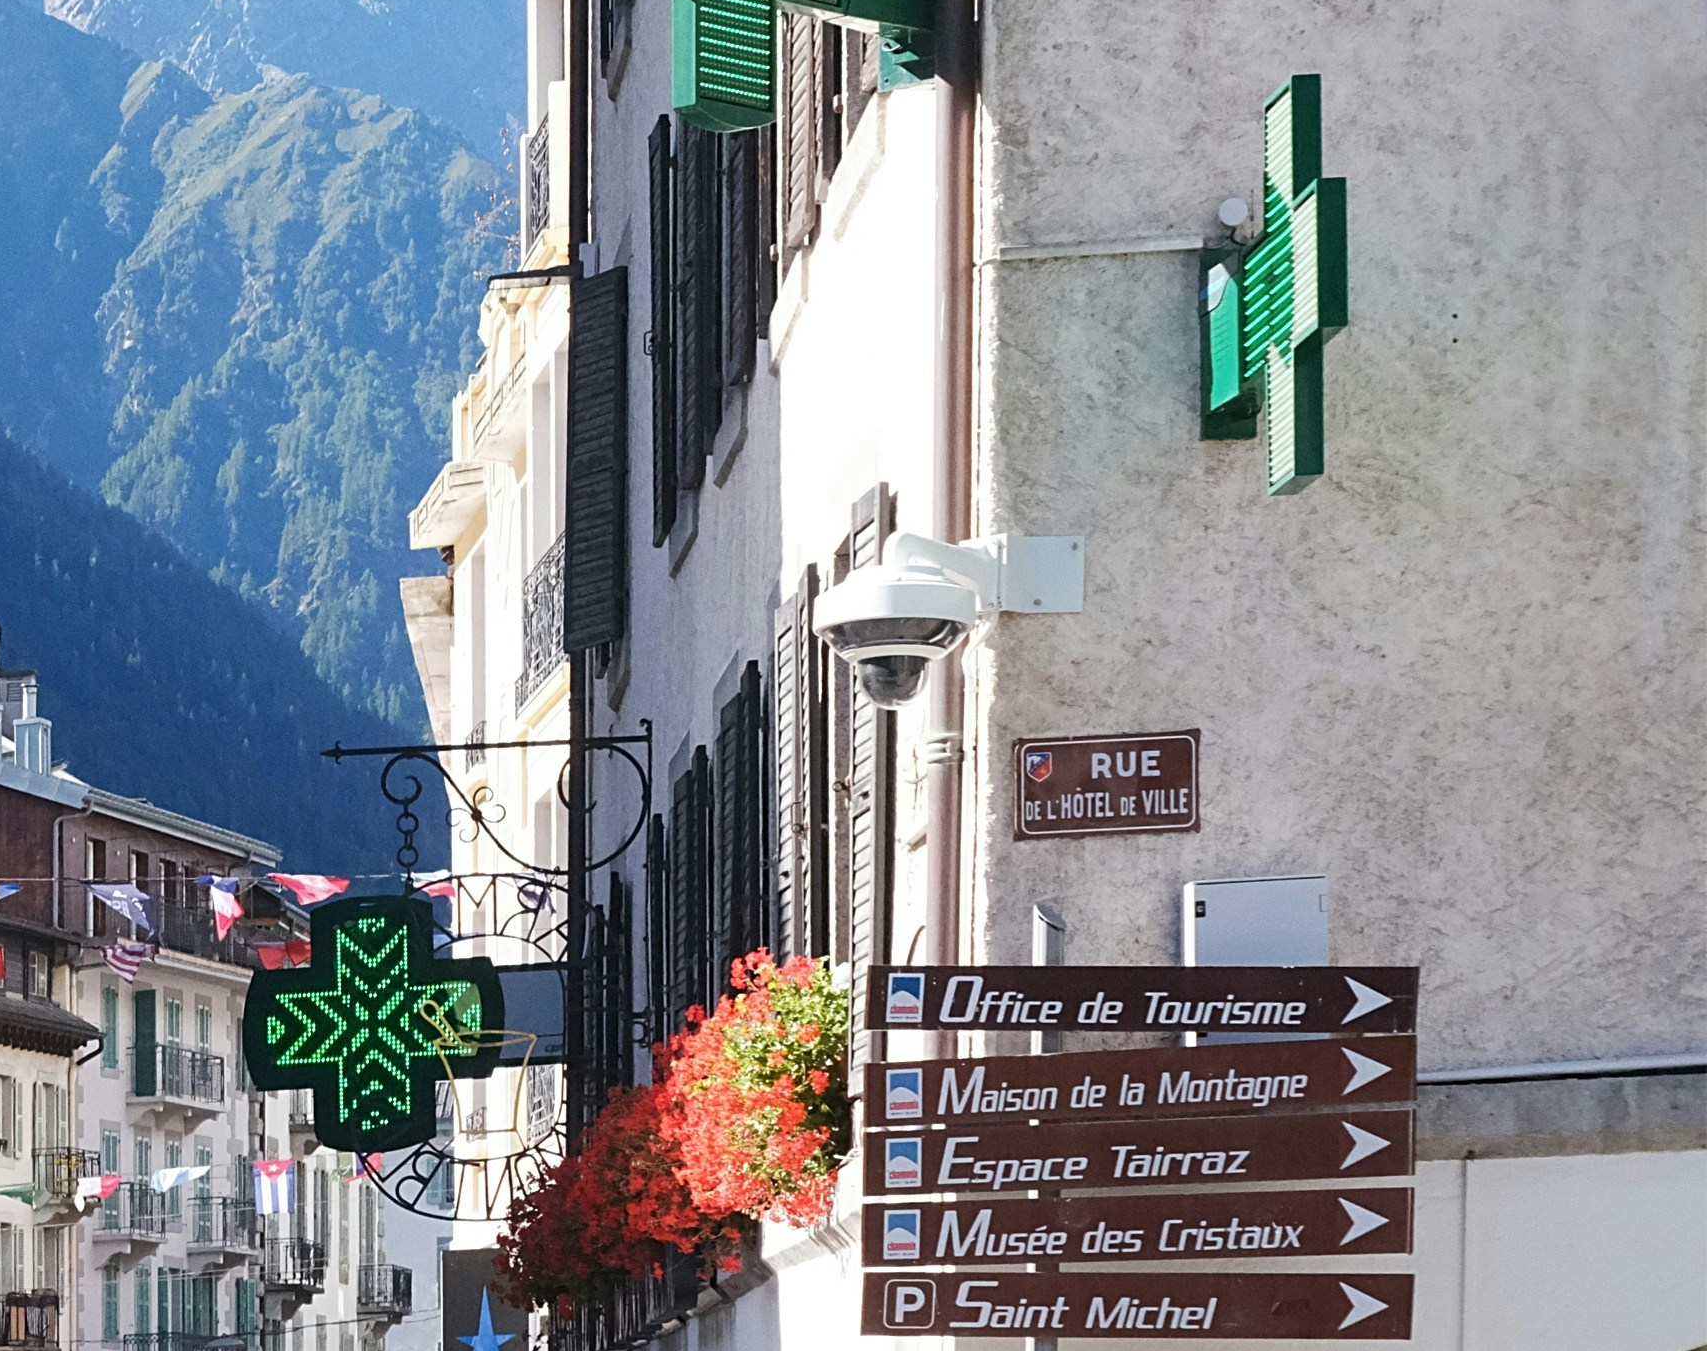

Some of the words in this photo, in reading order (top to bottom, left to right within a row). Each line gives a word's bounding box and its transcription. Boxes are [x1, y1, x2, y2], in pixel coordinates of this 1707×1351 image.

[1090, 750, 1162, 780] RUE
[1025, 799, 1043, 822] DE
[1119, 795, 1137, 817] DE
[1141, 788, 1189, 817] VILLE
[939, 974, 1063, 1026] Office
[1077, 991, 1122, 1025] de
[1143, 992, 1307, 1026] Tourisme
[937, 1067, 1057, 1116] Maison
[1070, 1074, 1108, 1109] de
[1117, 1073, 1143, 1106] la
[1156, 1070, 1309, 1105] Montagne
[938, 1136, 1088, 1190] Espace
[1110, 1145, 1249, 1179] Tairraz
[935, 1209, 1068, 1258] Musée
[1082, 1224, 1142, 1255] des
[1159, 1219, 1304, 1252] Cristaux
[894, 1286, 927, 1323] P
[950, 1280, 1069, 1330] Saint
[1085, 1297, 1218, 1331] Michel
